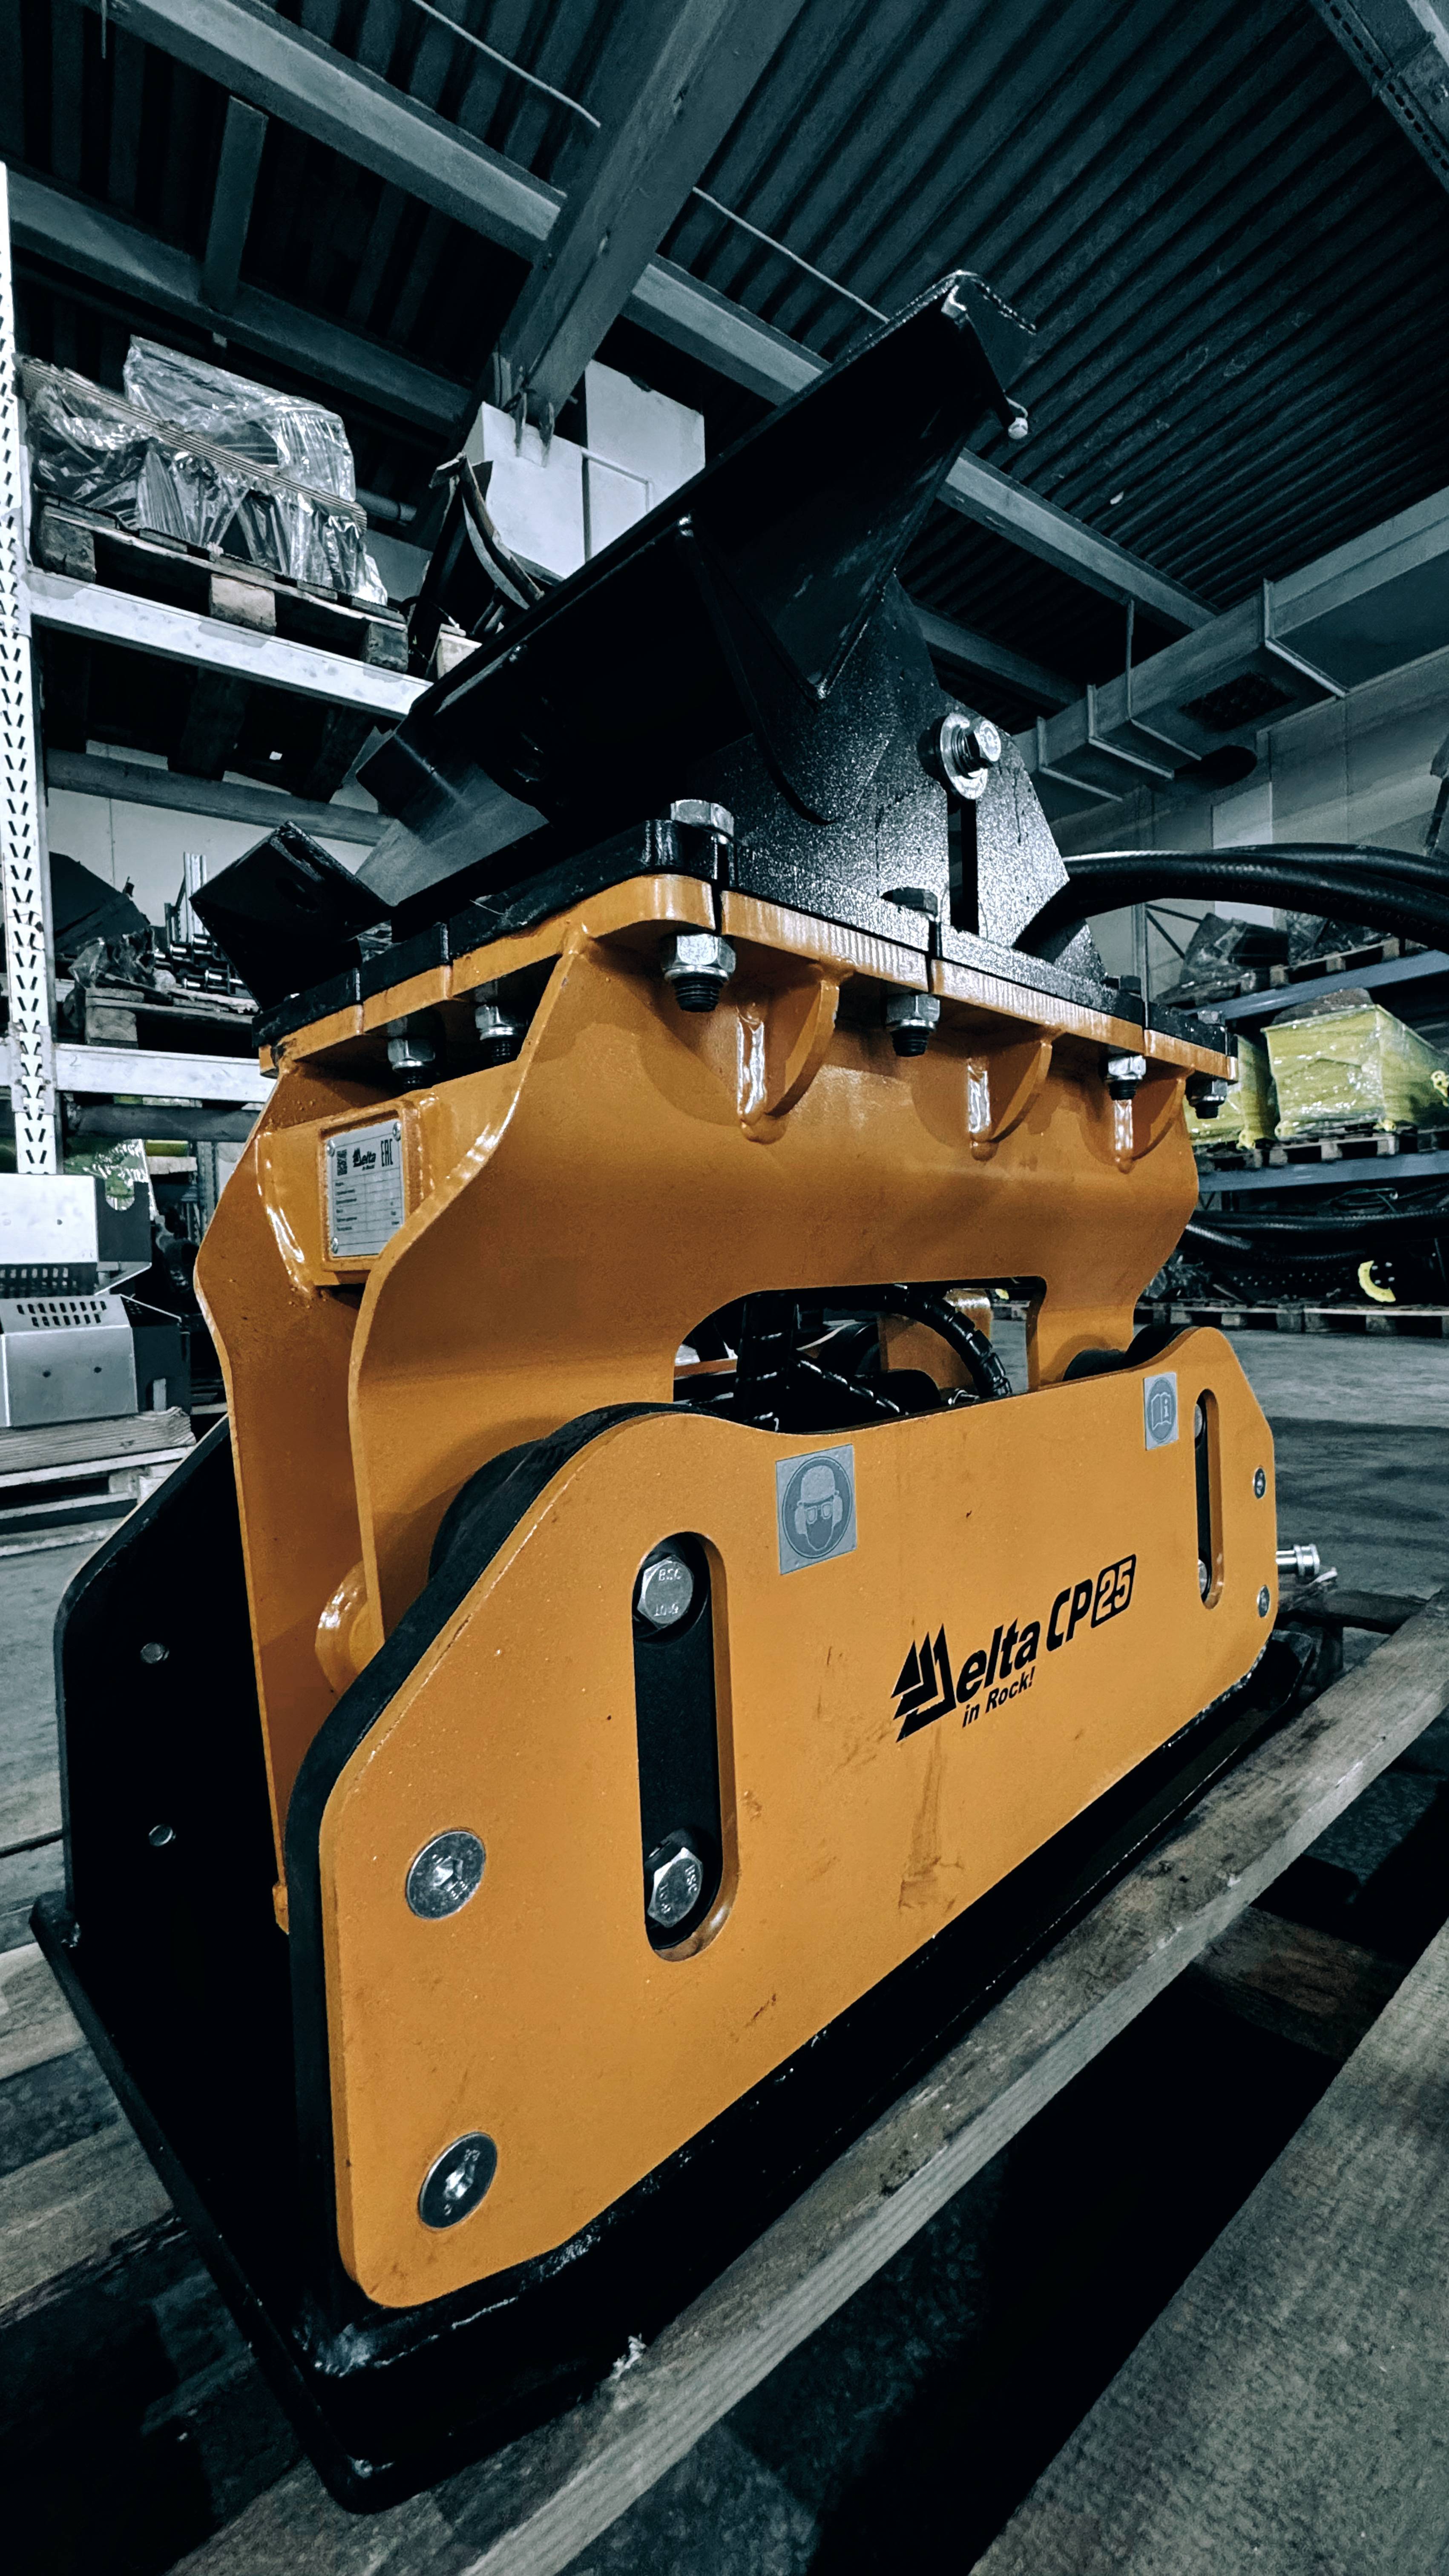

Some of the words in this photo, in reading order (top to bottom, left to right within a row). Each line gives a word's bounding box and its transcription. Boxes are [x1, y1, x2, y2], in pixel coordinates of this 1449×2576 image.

[380, 1138, 393, 1167] EAC
[890, 1617, 1041, 1743] Delta
[962, 1703, 980, 1728] in
[985, 1666, 1036, 1714] Rock!
